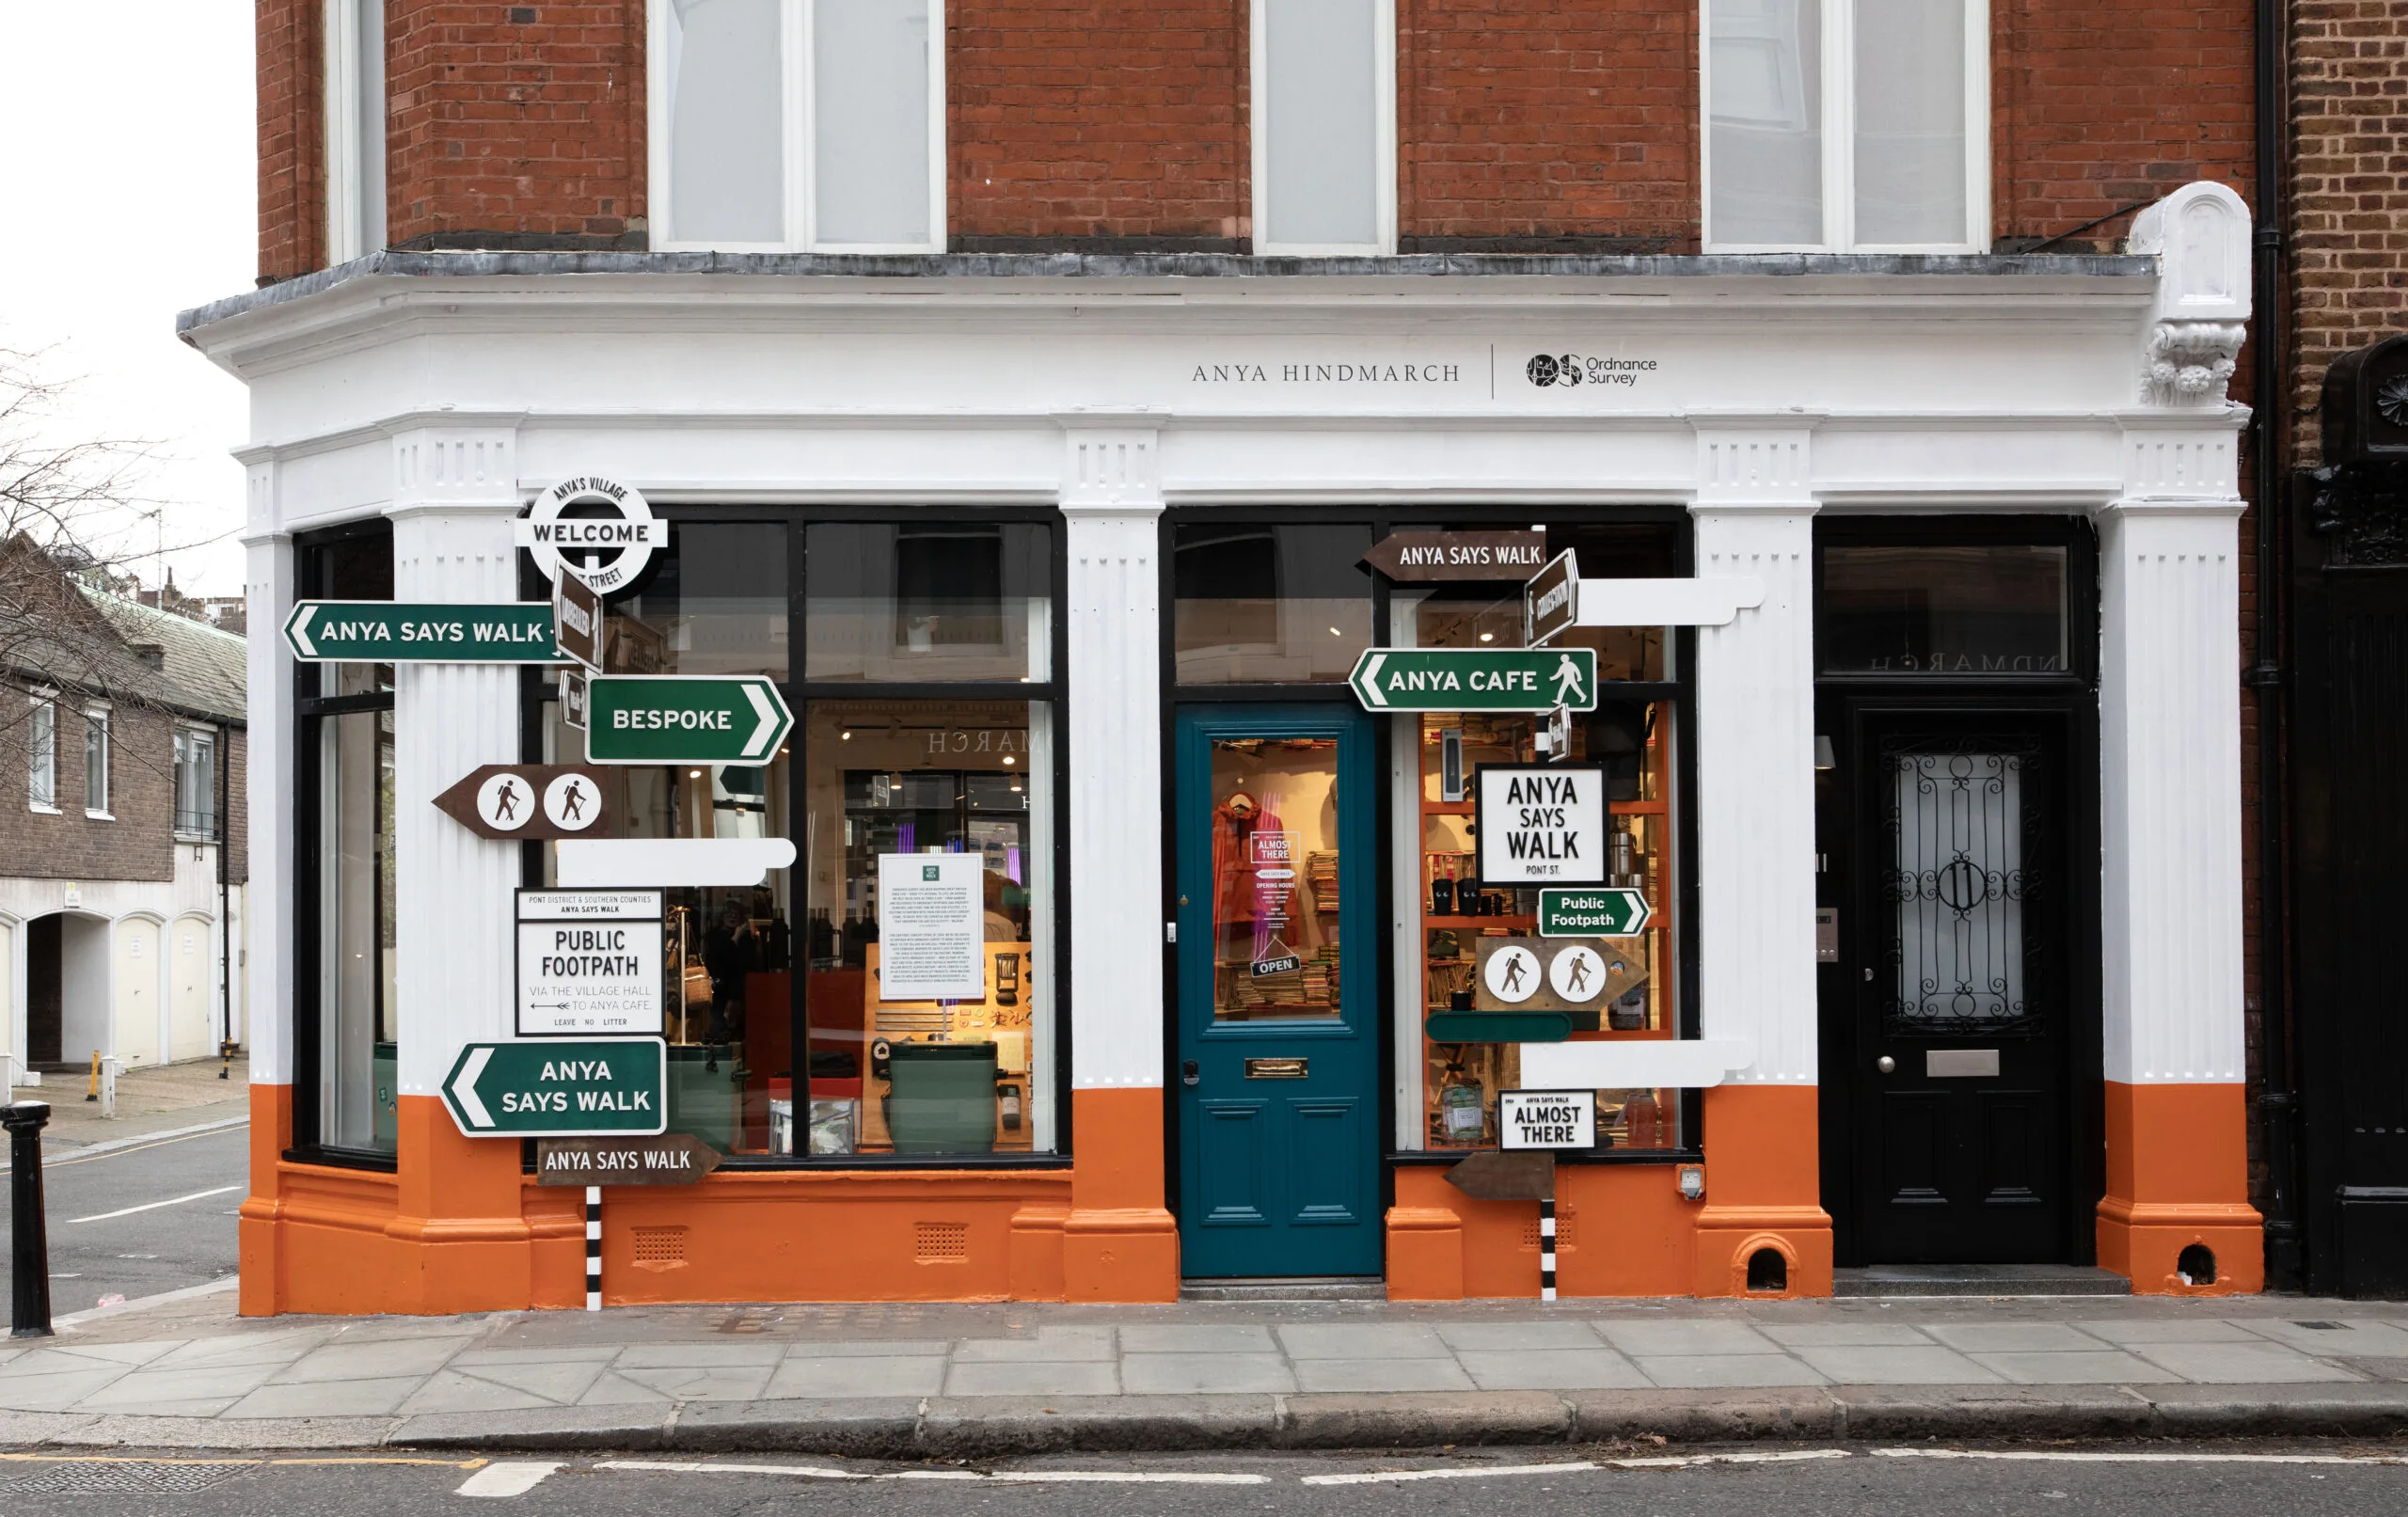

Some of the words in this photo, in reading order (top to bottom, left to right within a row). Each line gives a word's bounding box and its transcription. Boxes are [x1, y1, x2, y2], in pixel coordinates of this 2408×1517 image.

[1586, 356, 1656, 371] Ordnance
[1191, 364, 1267, 383] ANYA
[1283, 364, 1460, 383] HINDMARCH
[1588, 371, 1637, 386] Survey
[553, 478, 586, 501] ANYA'S
[590, 477, 628, 501] VILLAGE
[533, 525, 648, 542] WELCOME
[1400, 547, 1445, 564] ANYA
[1450, 546, 1490, 564] SAYS
[1496, 546, 1541, 563] WALK
[589, 567, 623, 588] STREET
[321, 622, 391, 641] ANYA
[400, 623, 464, 642] SAYS
[473, 623, 544, 642] WALK
[1388, 671, 1461, 691] ANYA
[1469, 671, 1538, 691] CAFE
[613, 709, 732, 730] BESPOKE
[1507, 777, 1577, 804] ANYA
[1520, 808, 1565, 828] SAYS
[1259, 841, 1292, 849] ALMOST
[1507, 831, 1579, 859] WALK
[1261, 850, 1290, 859] THERE
[1526, 865, 1546, 875] PONT
[1549, 865, 1560, 875] ST.
[1560, 897, 1605, 909] Public
[1551, 914, 1614, 927] Footpath
[555, 930, 626, 951] PUBLIC
[542, 956, 638, 976] FOOTPATH
[1259, 958, 1293, 974] OPEN
[530, 987, 547, 996] VIA
[551, 987, 572, 996] THE
[576, 987, 620, 996] VILLAGE
[624, 986, 651, 995] HALL
[572, 1001, 587, 1010] TO
[590, 1001, 619, 1010] ANYA
[623, 1000, 652, 1010] CAFE.
[540, 1061, 612, 1082] ANYA
[502, 1092, 568, 1112] SAYS
[577, 1091, 651, 1111] WALK
[1514, 1106, 1581, 1123] ALMOST
[1521, 1126, 1575, 1143] THERE
[546, 1151, 591, 1170] ANYA
[596, 1151, 639, 1170] SAYS
[643, 1150, 690, 1169] WALK
